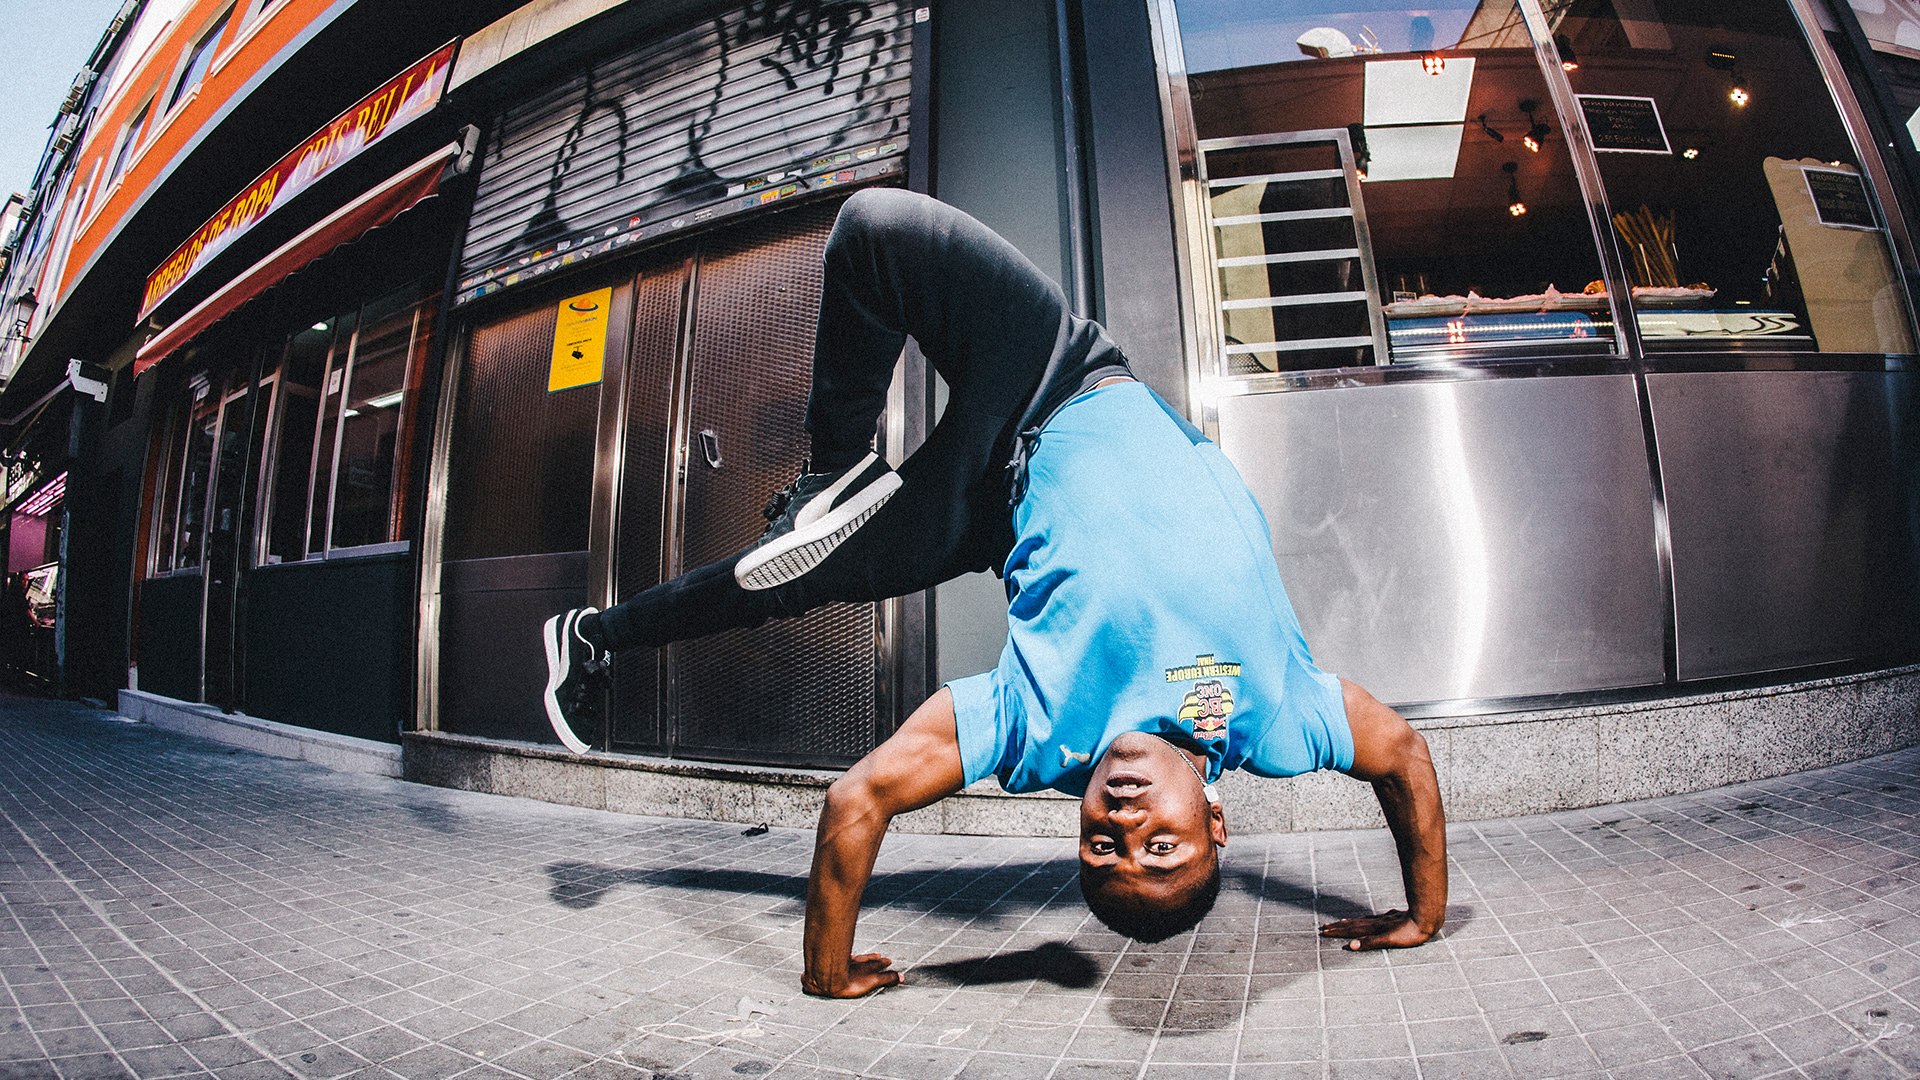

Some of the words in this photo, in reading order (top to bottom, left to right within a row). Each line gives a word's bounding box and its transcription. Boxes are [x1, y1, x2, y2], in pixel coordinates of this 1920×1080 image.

[142, 230, 207, 314] ARREGLOS
[206, 209, 231, 247] DE
[228, 171, 279, 233] ROPA
[291, 120, 350, 188] CRIS
[348, 60, 437, 153] BELLA
[1196, 654, 1214, 666] FINAL
[1166, 666, 1203, 682] EUROPE
[1203, 663, 1241, 677] WESTERN
[1196, 684, 1222, 699] ONE
[1198, 698, 1223, 717] BC
